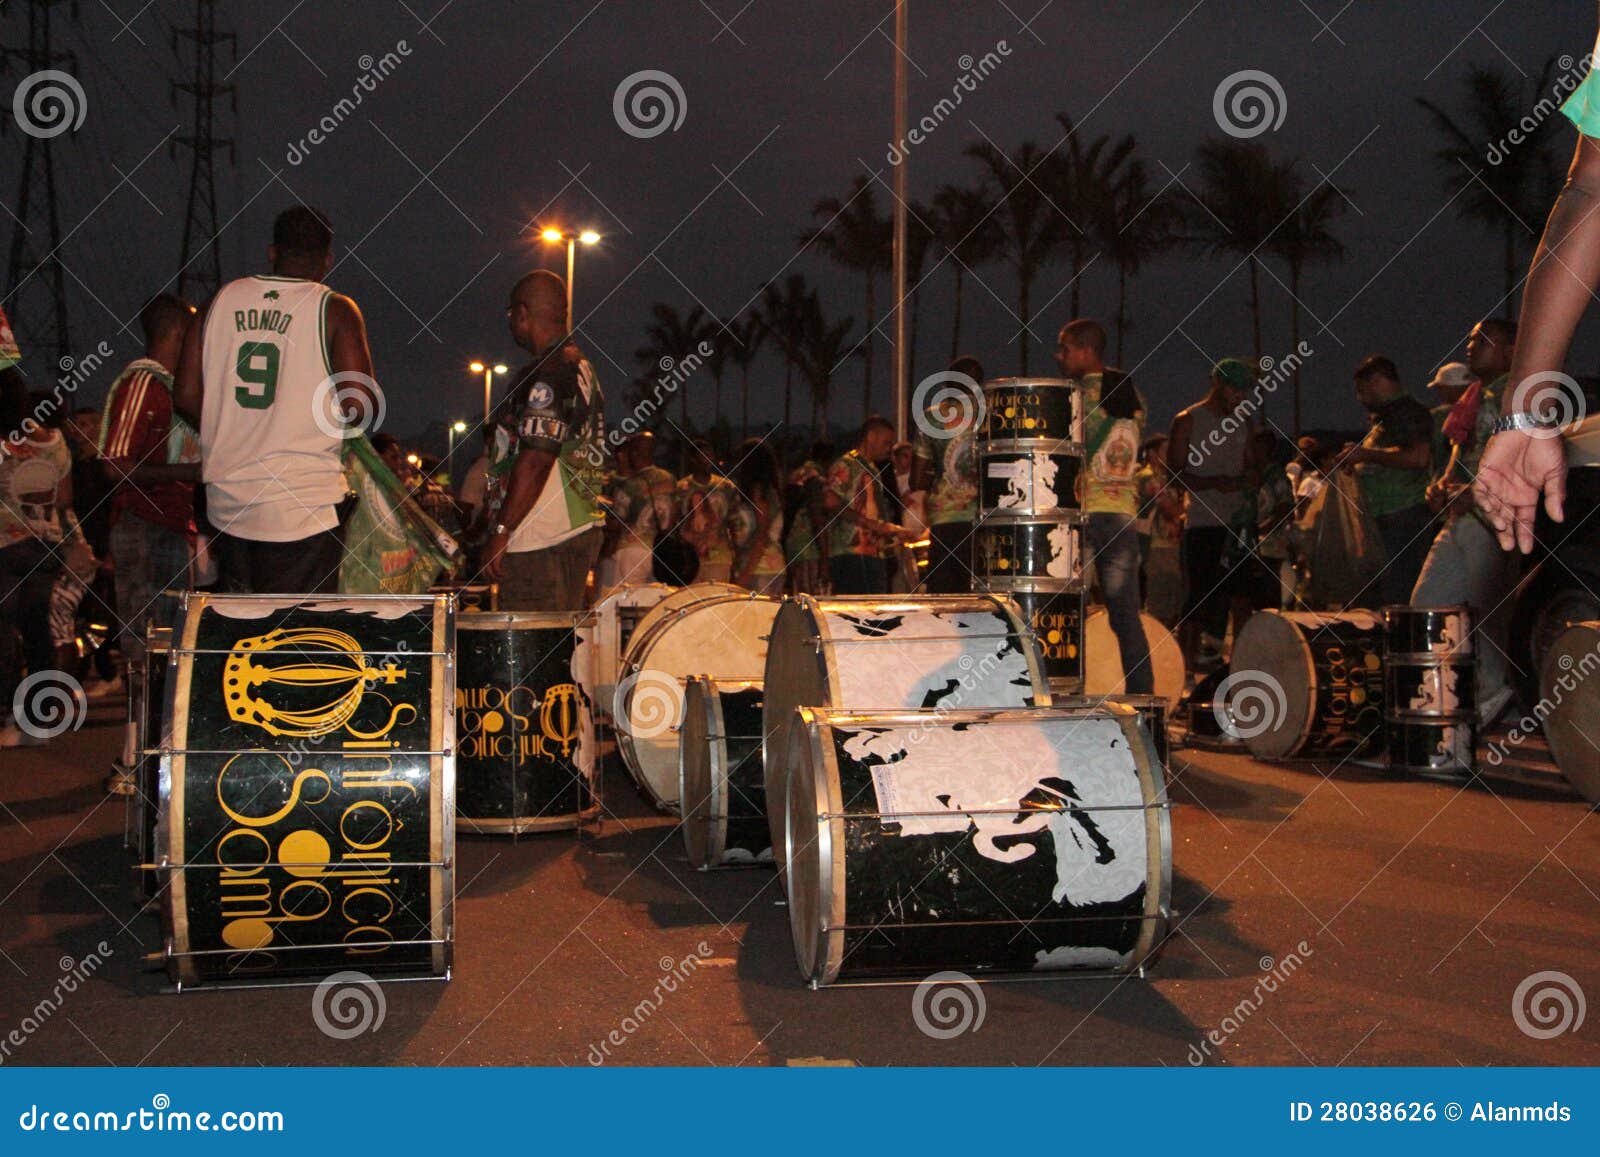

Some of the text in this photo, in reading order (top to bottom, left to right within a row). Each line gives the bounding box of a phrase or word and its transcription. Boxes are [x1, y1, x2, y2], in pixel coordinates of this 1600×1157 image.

[235, 309, 293, 335] RONDO
[235, 341, 281, 410] 9
[456, 734, 556, 766] Sinfônic
[217, 749, 332, 972] Samba
[341, 691, 418, 955] Sinfônica
[278, 830, 333, 921] da
